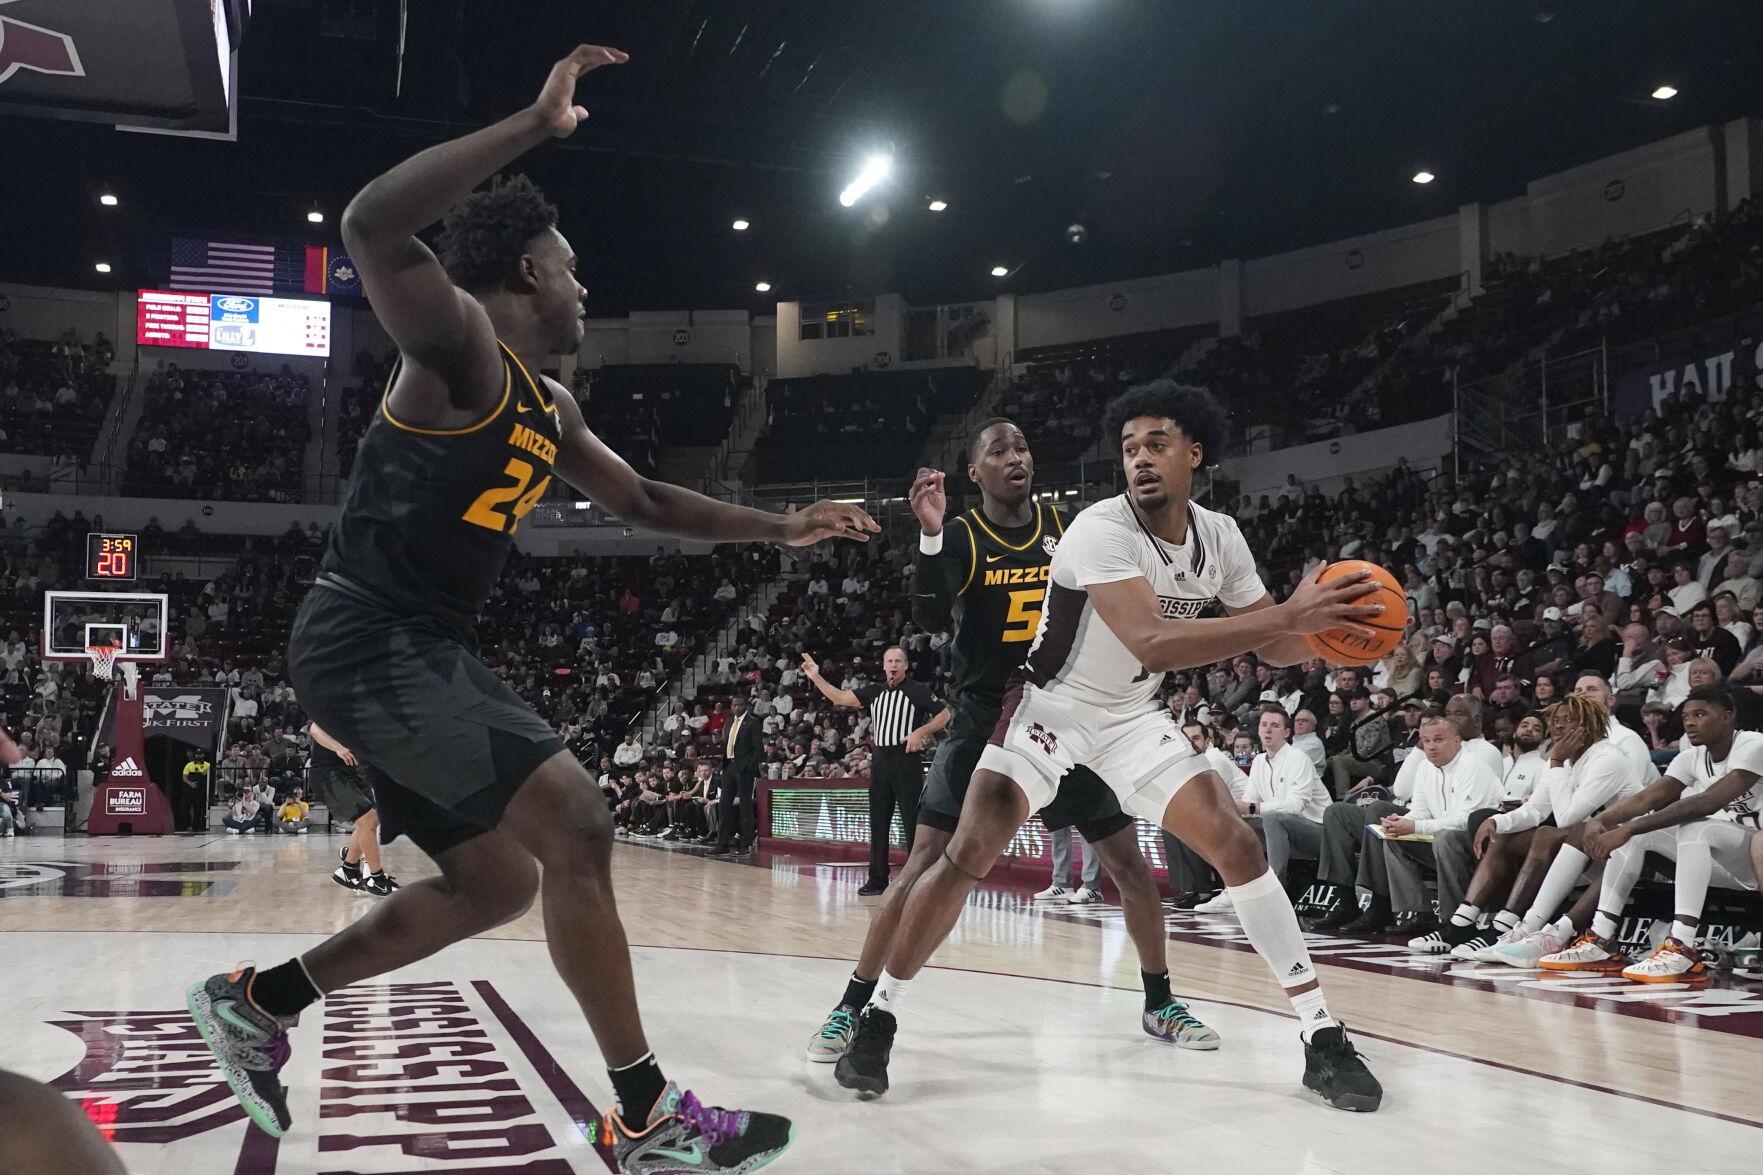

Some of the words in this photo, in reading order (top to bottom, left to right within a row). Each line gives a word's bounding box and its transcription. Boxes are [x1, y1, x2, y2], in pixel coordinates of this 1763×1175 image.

[508, 423, 559, 466] MIZZO
[461, 456, 553, 535] 24
[102, 539, 132, 552] 3:59
[97, 552, 126, 575] 20
[984, 565, 1051, 586] MIZZO
[1002, 588, 1046, 643] 5
[112, 768, 143, 777] adidas
